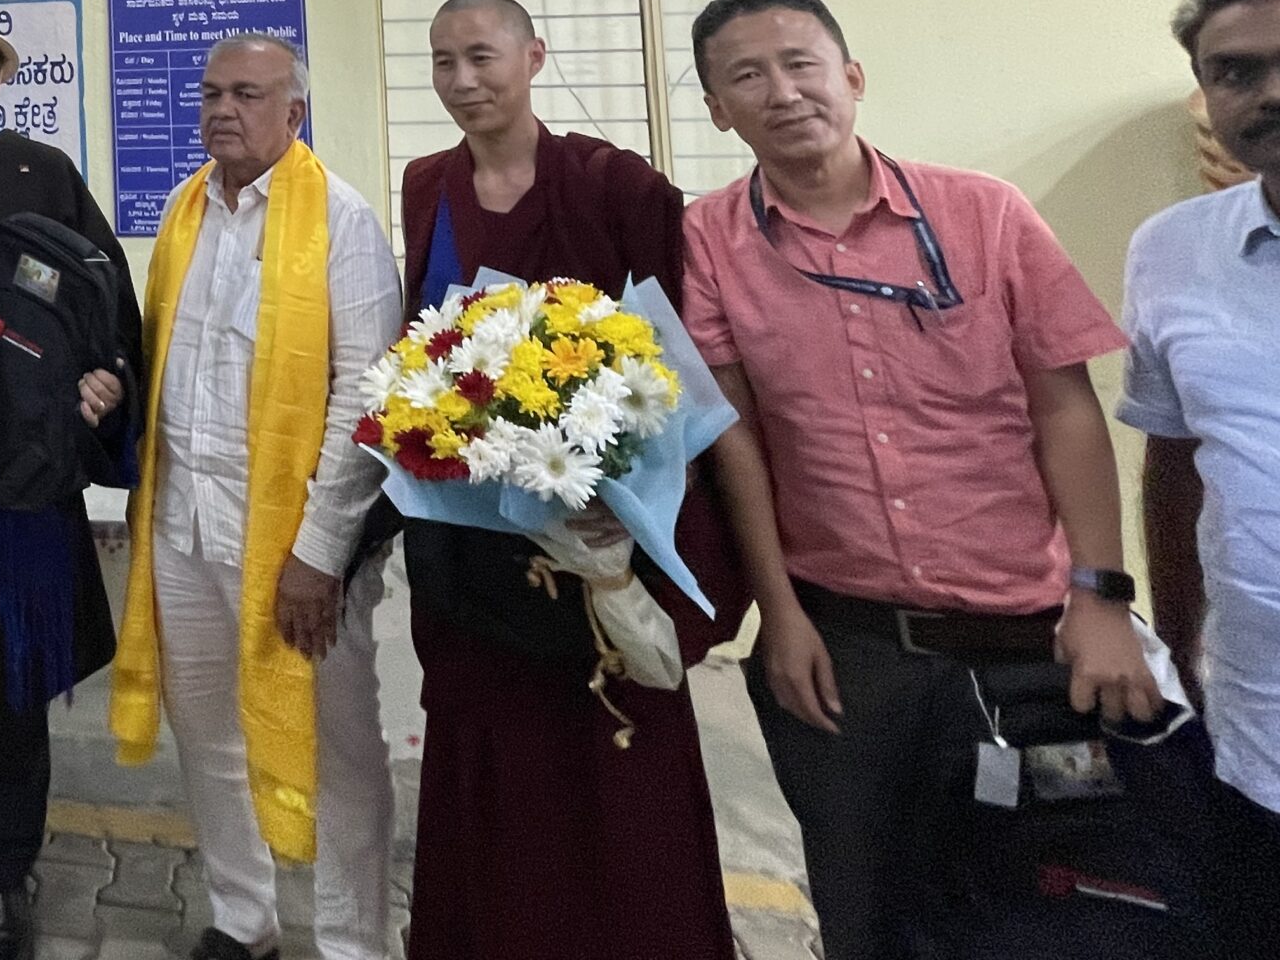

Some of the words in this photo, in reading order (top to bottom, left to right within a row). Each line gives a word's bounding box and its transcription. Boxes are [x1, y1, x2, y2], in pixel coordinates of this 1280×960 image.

[119, 30, 143, 43] Place
[145, 29, 162, 42] and
[164, 29, 188, 42] Time
[189, 29, 200, 41] to
[201, 29, 224, 40] meet
[267, 25, 297, 37] Public
[141, 56, 155, 65] Day
